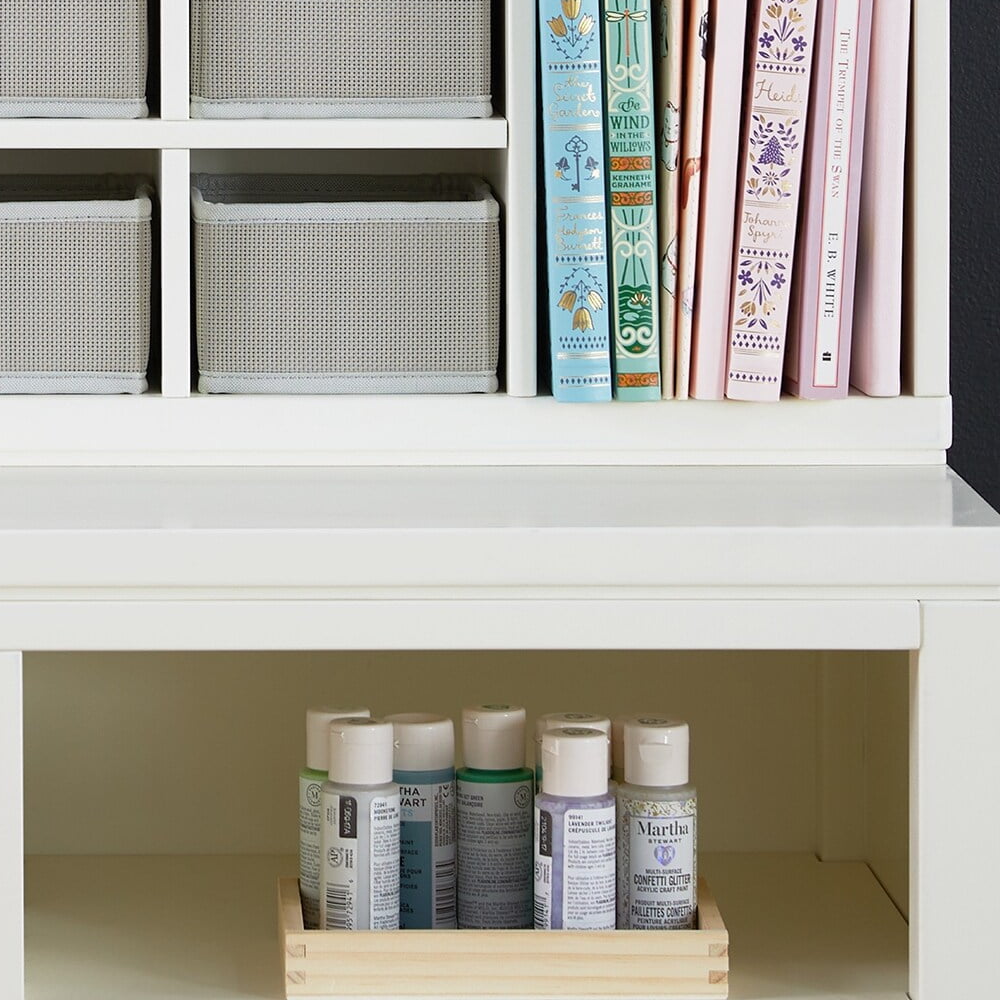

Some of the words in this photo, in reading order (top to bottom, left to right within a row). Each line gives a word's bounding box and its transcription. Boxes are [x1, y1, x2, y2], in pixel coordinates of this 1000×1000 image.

[610, 116, 650, 129] WIND
[835, 118, 843, 133] OF
[610, 141, 651, 153] WILLOWS
[831, 164, 842, 198] SWAN
[828, 233, 838, 244] E.
[827, 251, 837, 262] B.
[824, 269, 836, 317] WHITE
[637, 821, 689, 836] Martha
[633, 873, 667, 886] CONFETTI
[669, 873, 691, 886] GLITTER
[631, 905, 665, 918] PAILLETTES
